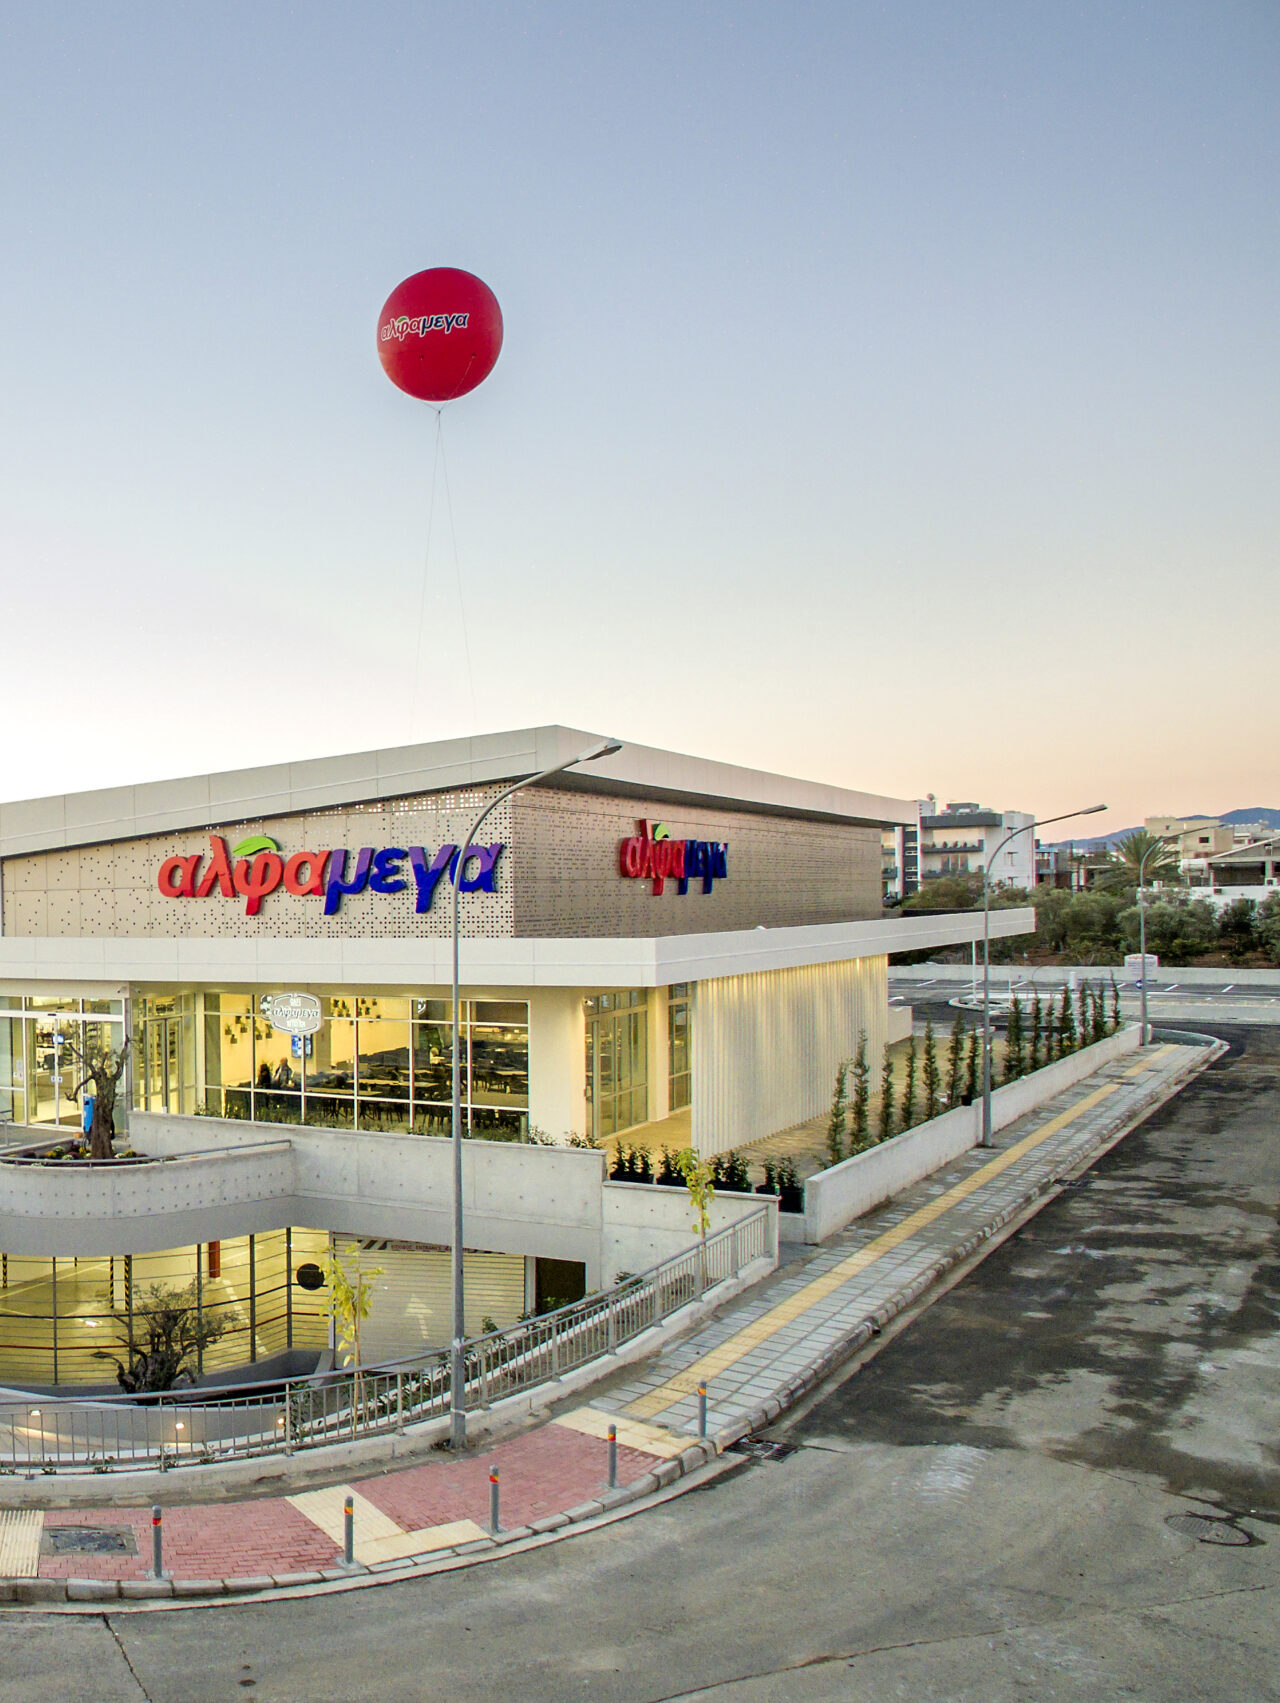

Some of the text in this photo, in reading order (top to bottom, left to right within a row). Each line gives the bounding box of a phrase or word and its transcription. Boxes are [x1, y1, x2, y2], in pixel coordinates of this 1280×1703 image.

[381, 313, 470, 341] αλφαμεγα
[157, 834, 506, 916] αλφαμεγα
[619, 819, 728, 896] αλφαμεγα
